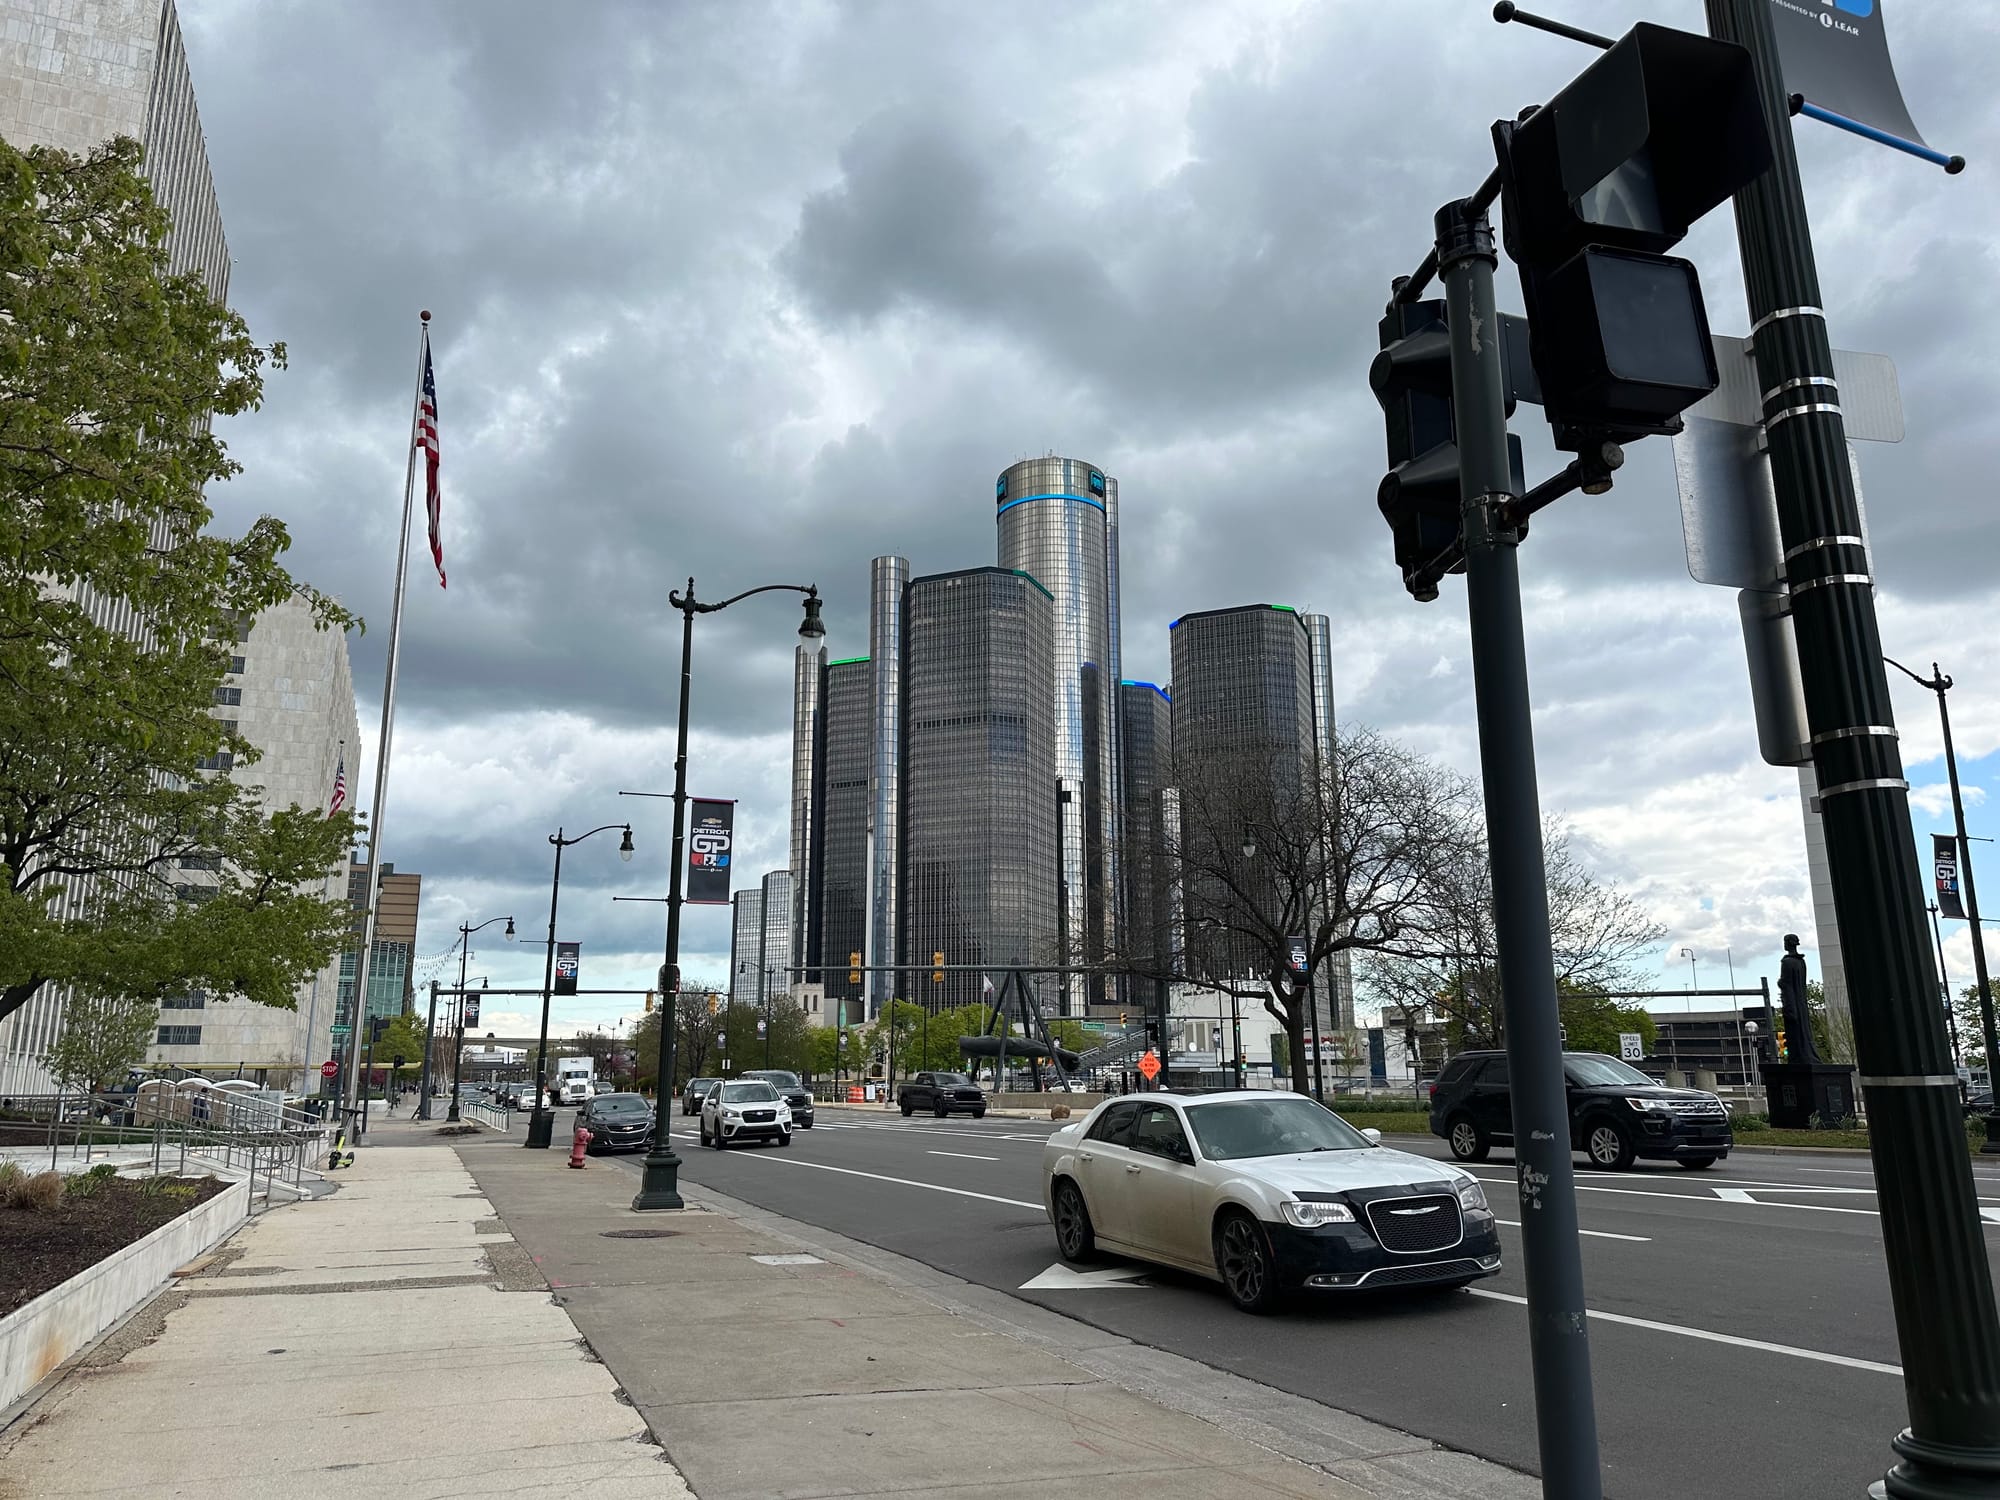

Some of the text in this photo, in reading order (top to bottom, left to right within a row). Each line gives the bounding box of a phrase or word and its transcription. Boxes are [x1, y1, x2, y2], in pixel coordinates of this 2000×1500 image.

[1808, 10, 1818, 19] BY
[1834, 20, 1860, 36] LEAR
[692, 828, 731, 836] DETROIT
[692, 834, 730, 854] GP
[1936, 864, 1956, 879] GP
[557, 960, 578, 970] GP
[1624, 1047, 1641, 1058] 30
